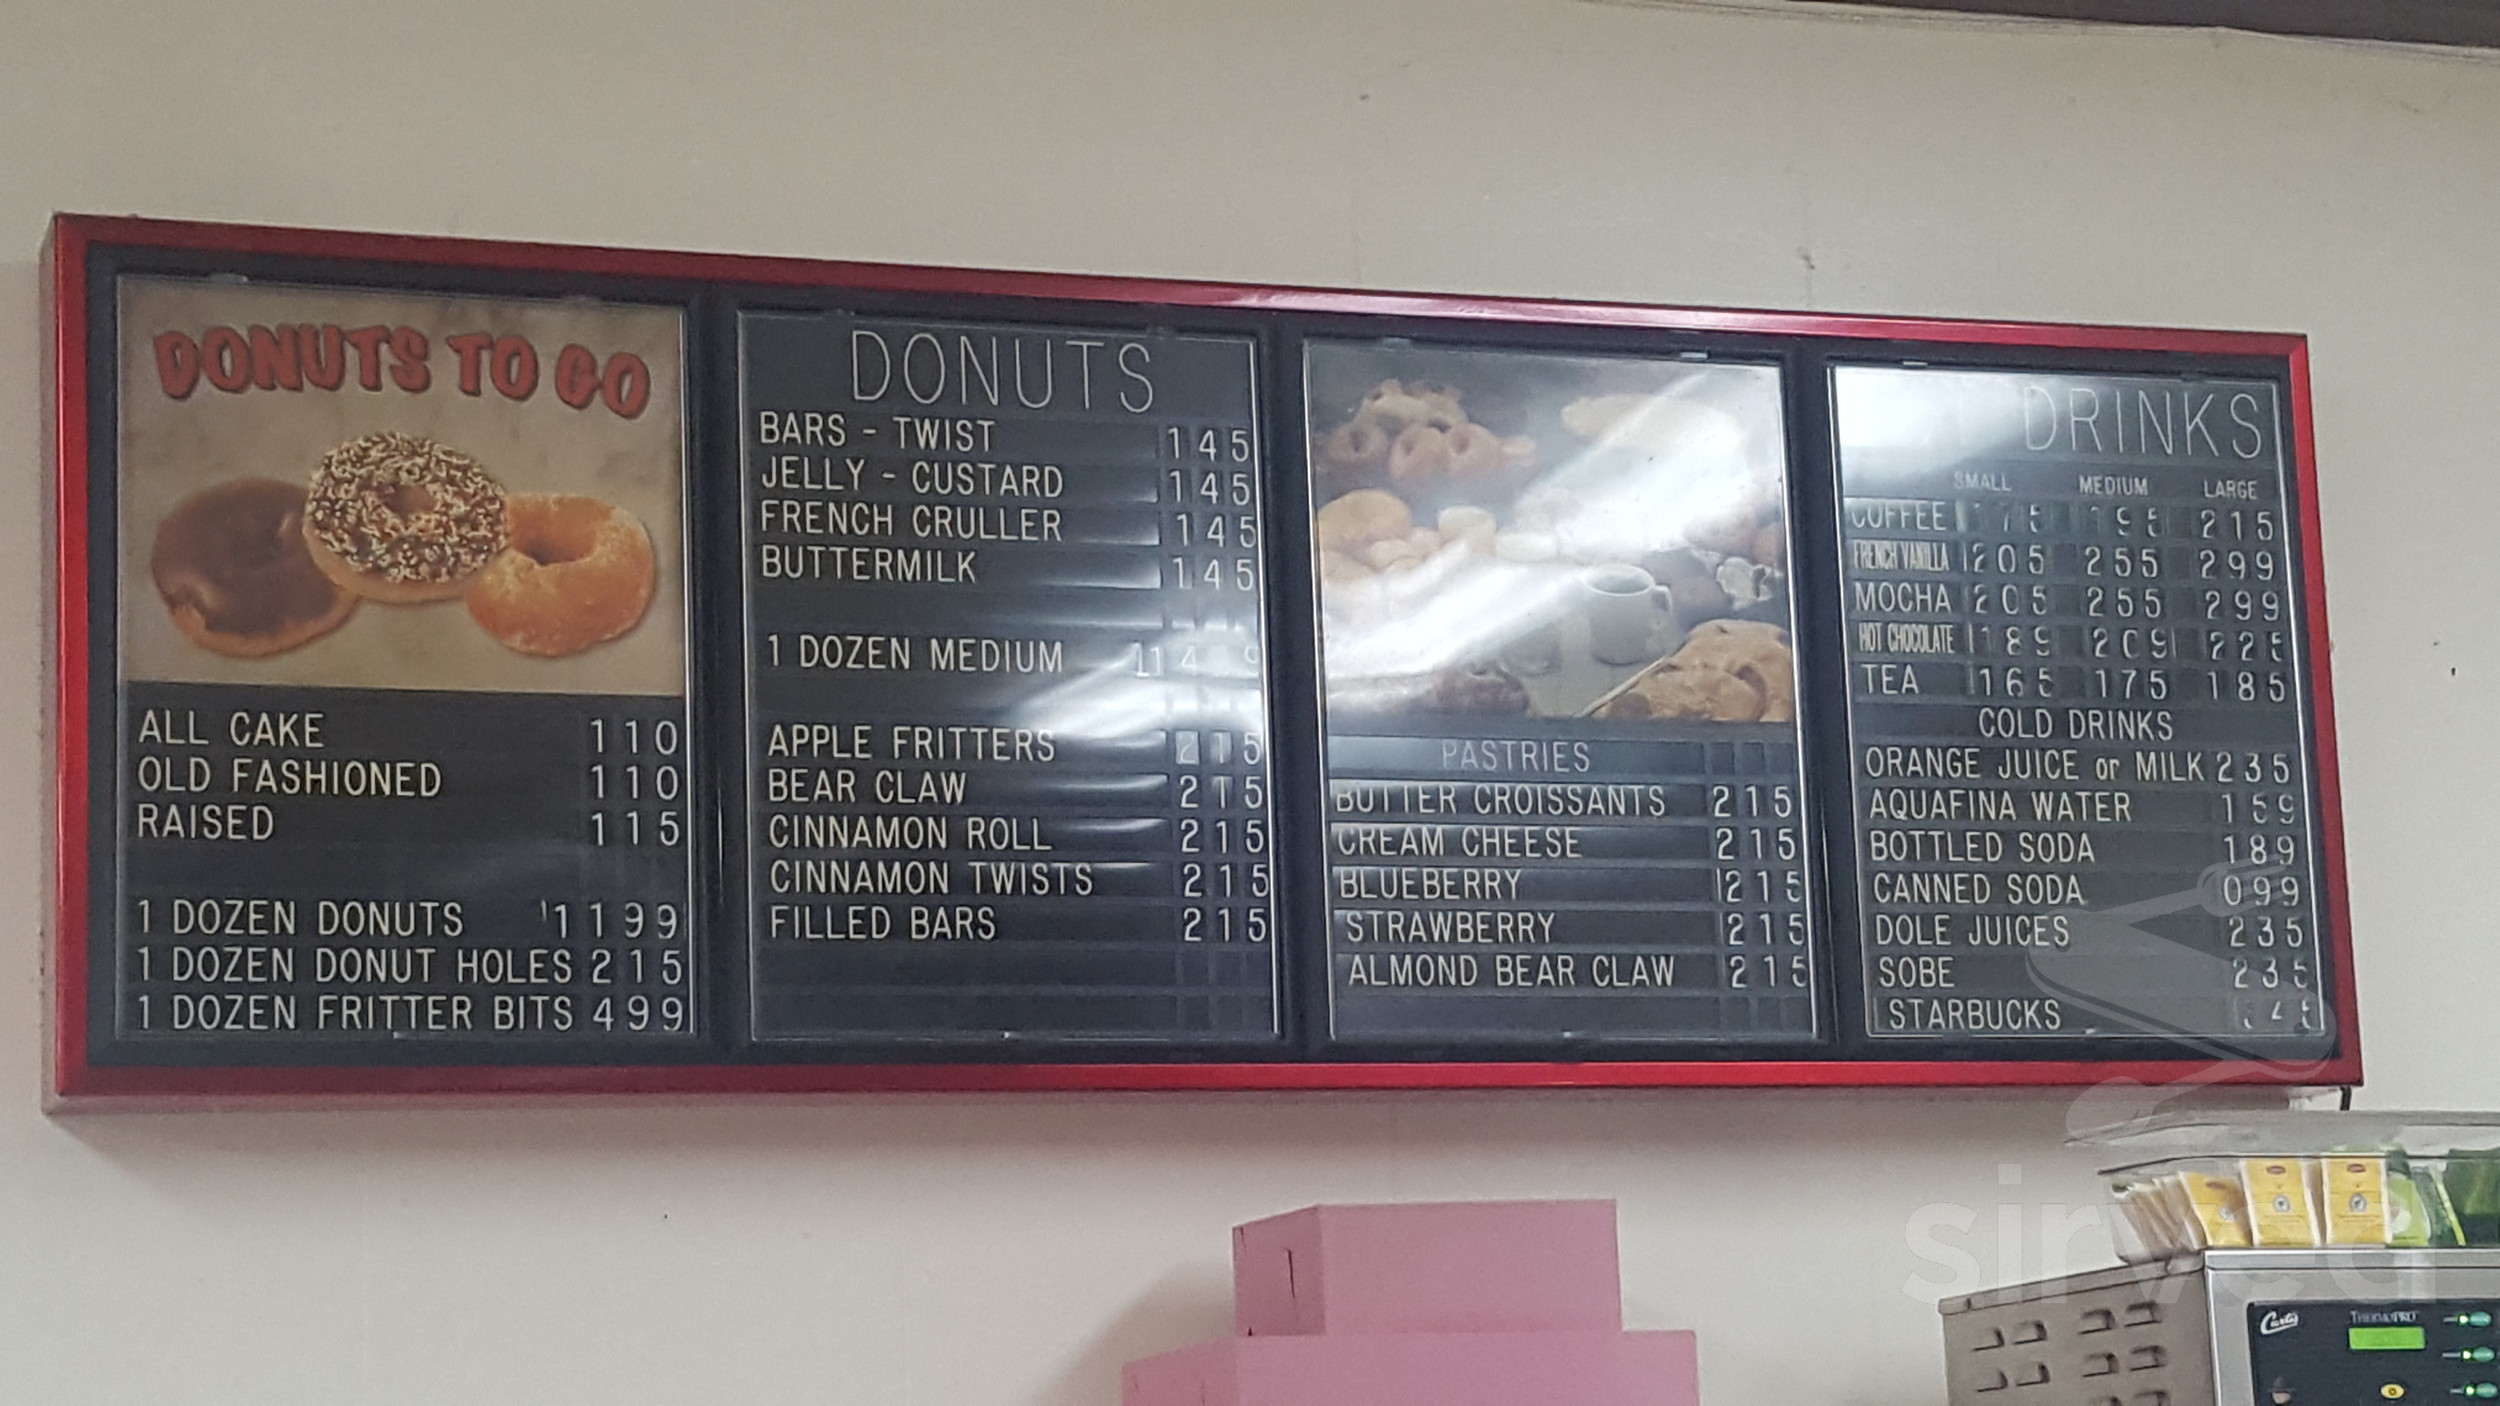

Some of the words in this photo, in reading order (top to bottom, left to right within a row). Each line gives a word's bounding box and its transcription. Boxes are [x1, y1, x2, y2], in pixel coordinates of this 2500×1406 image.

[153, 323, 431, 401] DONUTS
[446, 331, 539, 402] TO
[554, 342, 651, 420] GO
[852, 330, 1154, 413] DONUTS
[760, 411, 846, 447] BARS
[893, 416, 996, 452] TWIST
[1167, 427, 1249, 463] 145
[2024, 385, 2262, 460] DRINKS
[761, 456, 866, 491] JELLY
[913, 462, 1063, 498] CUSTARD
[1169, 470, 1251, 505] 145
[1954, 471, 2012, 492] SMALL
[2079, 475, 2148, 496] MEDIUM
[2204, 480, 2258, 499] LARGE
[761, 500, 893, 536] FRENCH
[913, 505, 1062, 542] CRULLER
[1176, 513, 1256, 548] 145
[1851, 501, 1947, 531] COFFEE
[2200, 509, 2273, 541] 215
[762, 546, 975, 583] BUTTERMILK
[1172, 557, 1254, 591] 145
[1853, 540, 1898, 571] FRENCH
[1901, 541, 1949, 572] VANILLA
[2085, 547, 2158, 578] 255
[2200, 550, 2273, 580] 299
[1854, 581, 1951, 613] MOCHA
[1974, 584, 2046, 615] 205
[2087, 586, 2161, 618] 255
[2205, 590, 2278, 621] 299
[768, 634, 780, 668] 1
[801, 635, 911, 670] DOZEN
[931, 638, 1063, 673] MEDIUM
[1859, 622, 1881, 652] HOT
[1887, 622, 1954, 654] CHOCOLATE
[1861, 664, 1919, 694] TEA
[2095, 669, 2167, 700] 175
[2208, 671, 2285, 702] 185
[139, 709, 209, 745] ALL
[230, 712, 325, 748] CAKE
[591, 718, 678, 755] 110
[768, 724, 872, 759] APPLE
[894, 726, 1055, 761] FRITTERS
[1979, 709, 2053, 738] COLD
[2069, 710, 2173, 741] DRINKS
[1443, 741, 1590, 773] PASTRIES
[1865, 746, 1980, 779] ORANGE
[1997, 749, 2079, 780] JUICE
[2095, 755, 2120, 780] or
[2135, 751, 2204, 782] MILK
[2217, 752, 2290, 784] 235
[138, 756, 211, 792] OLD
[233, 758, 441, 797] FASHIONED
[591, 764, 679, 800] 110
[768, 769, 856, 803] BEAR
[876, 770, 966, 804] CLAW
[1180, 775, 1263, 809] 215
[1475, 785, 1665, 817] CROISSANTS
[1714, 785, 1792, 818] 215
[1869, 789, 2016, 822] AQUAFINA
[2031, 791, 2132, 823] WATER
[138, 803, 274, 840] RAISED
[591, 811, 680, 846] 115
[769, 814, 946, 849] CINNAMON
[968, 817, 1052, 850] ROLL
[1181, 818, 1264, 854] 215
[1338, 826, 1444, 856] CREAM
[1462, 826, 1582, 858] CHEESE
[1716, 828, 1796, 861] 215
[1870, 830, 2002, 862] BOTTLED
[2019, 832, 2095, 863] SODA
[2224, 834, 2294, 865] 189
[770, 860, 948, 894] CINNAMON
[968, 861, 1092, 896] TWISTS
[1184, 863, 1268, 897] 215
[1339, 869, 1522, 901] BLUEBERRY
[1873, 873, 1990, 904] CANNED
[2007, 874, 2084, 906] SODA
[138, 899, 150, 934] 1
[173, 899, 296, 935] DOZEN
[318, 900, 463, 937] DONUTS
[771, 905, 890, 940] FILLED
[911, 906, 996, 940] BARS
[1183, 907, 1266, 942] 215
[1347, 911, 1555, 944] STRAWBERRY
[1728, 912, 1804, 945] 215
[1876, 914, 1951, 946] DOLE
[1968, 915, 2070, 947] JUICES
[2229, 916, 2303, 948] 235
[138, 946, 150, 982] 1
[173, 946, 293, 982] DOZEN
[316, 948, 436, 983] DONUT
[457, 948, 572, 984] HOLES
[592, 948, 682, 985] 215
[1349, 954, 1477, 986] ALMOND
[1497, 955, 1575, 987] BEAR
[1592, 956, 1674, 988] CLAW
[1731, 956, 1806, 989] 215
[1878, 957, 1955, 988] SOBE
[138, 994, 150, 1030] 1
[173, 994, 296, 1030] DOZEN
[318, 995, 472, 1030] FRITTER
[494, 995, 573, 1031] BITS
[593, 995, 683, 1032] 499
[1888, 1000, 2062, 1031] STARBUCKS
